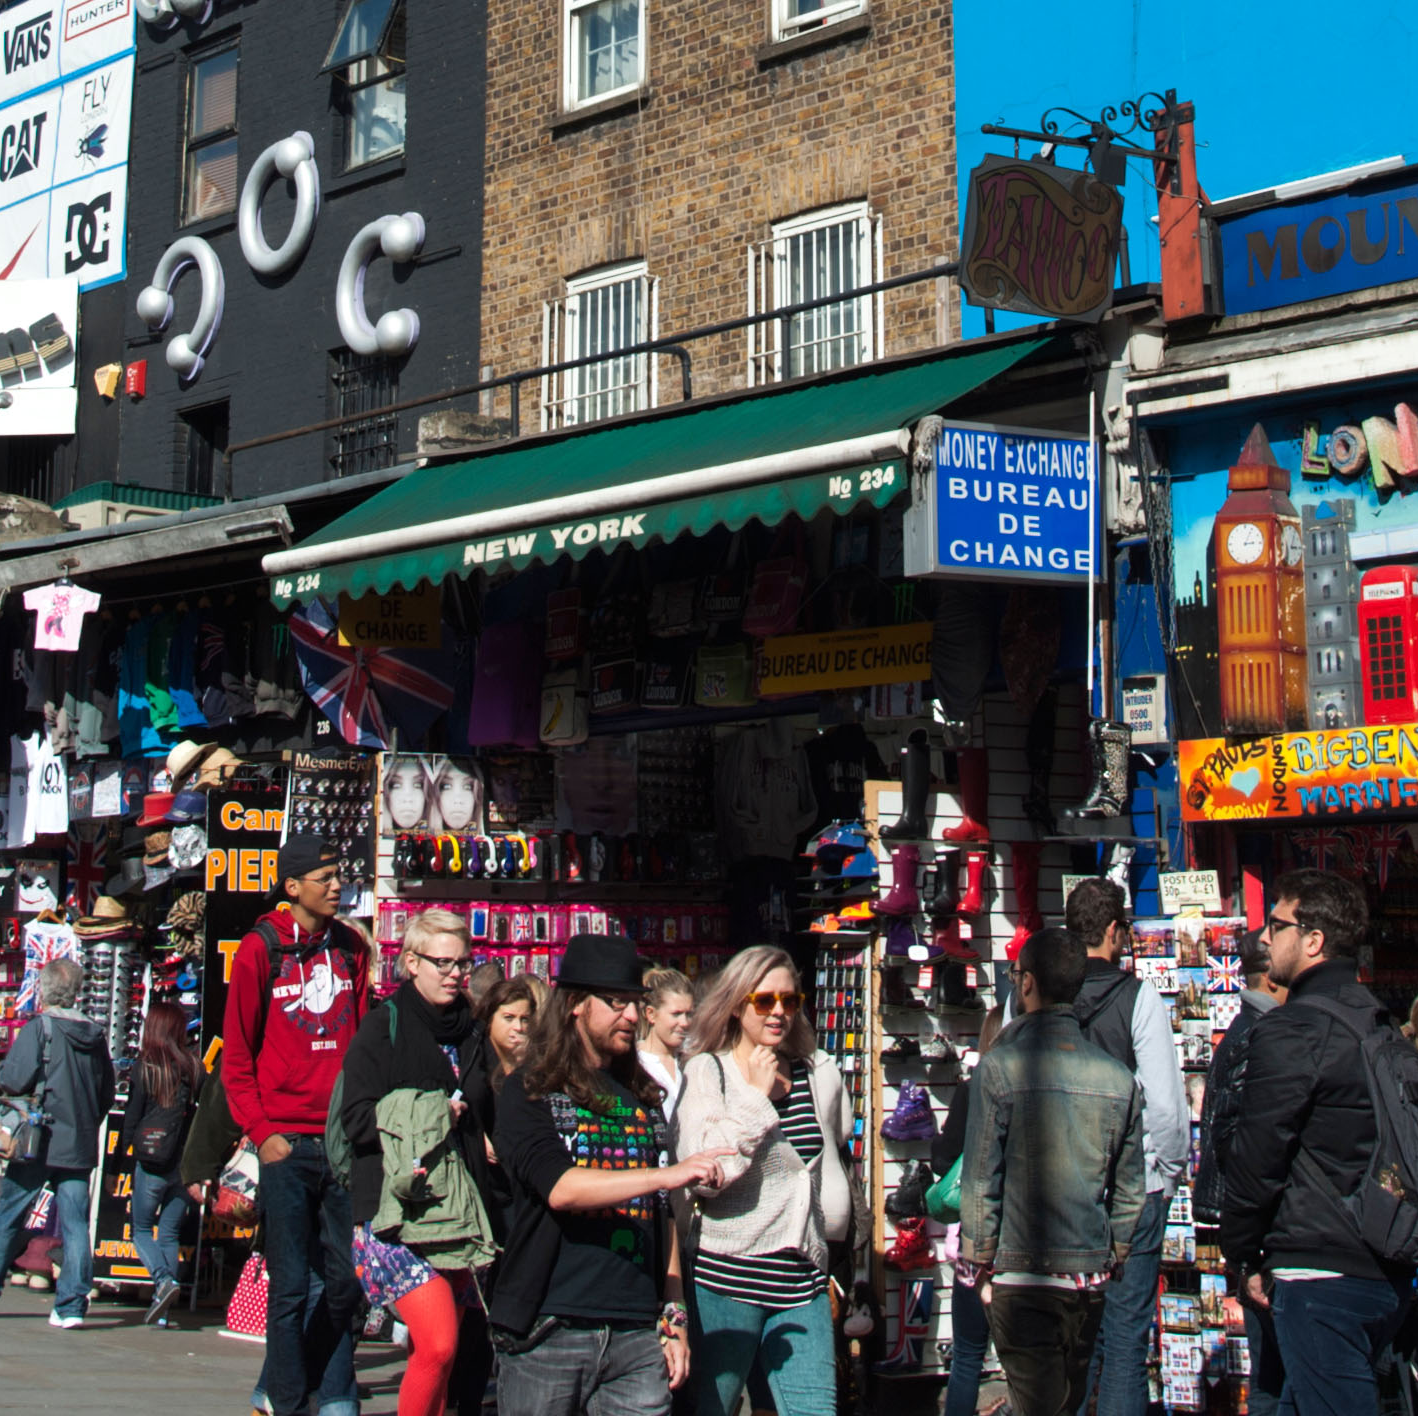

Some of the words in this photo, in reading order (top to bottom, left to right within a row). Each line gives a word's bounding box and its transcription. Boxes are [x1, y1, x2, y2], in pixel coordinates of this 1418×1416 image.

[3, 10, 53, 75] VANS
[82, 71, 112, 113] FLY
[0, 111, 48, 183] CAT
[65, 191, 112, 274] DC
[938, 431, 998, 472] MONEY
[858, 466, 896, 494] 234
[948, 477, 1088, 510] BUREAU
[463, 531, 533, 567] NEW
[549, 512, 646, 550] YORK
[998, 512, 1042, 537] DE
[949, 539, 1091, 572] CHANGE
[296, 573, 321, 594] 234
[380, 600, 404, 619] DE
[355, 620, 429, 643] CHANGE
[761, 650, 831, 679] BUREAU
[833, 649, 858, 673] DE
[860, 641, 933, 671] CHANGE
[316, 720, 331, 735] 236
[1129, 709, 1148, 720] 0500
[221, 801, 287, 831] Cam
[205, 848, 279, 892] PIER
[1163, 876, 1187, 886] POST
[1188, 874, 1214, 884] CARD
[1164, 885, 1181, 897] 30p
[1204, 884, 1215, 895] £1
[272, 984, 302, 999] NEW
